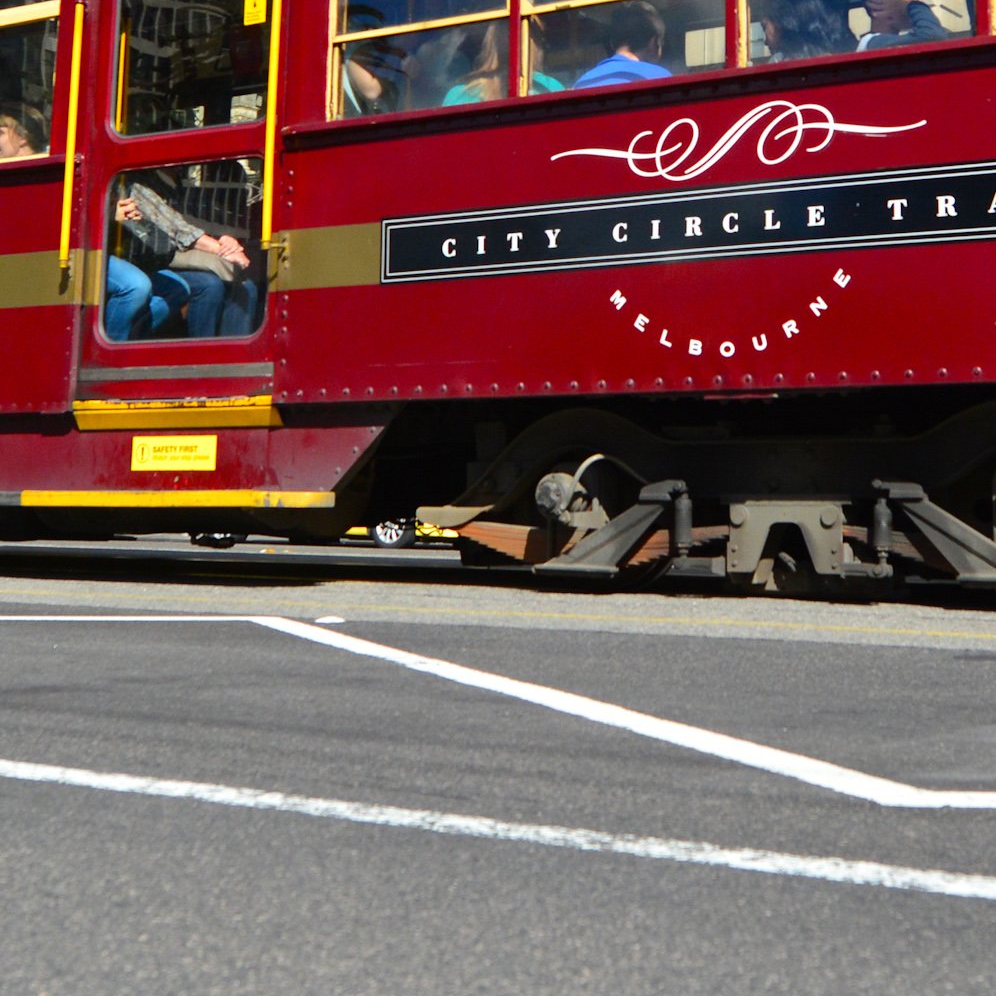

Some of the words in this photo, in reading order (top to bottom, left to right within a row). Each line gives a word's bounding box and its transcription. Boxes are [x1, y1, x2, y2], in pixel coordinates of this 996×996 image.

[441, 228, 561, 258] CITY
[611, 205, 826, 243] CIRCLE
[609, 268, 852, 357] MELBOURNE
